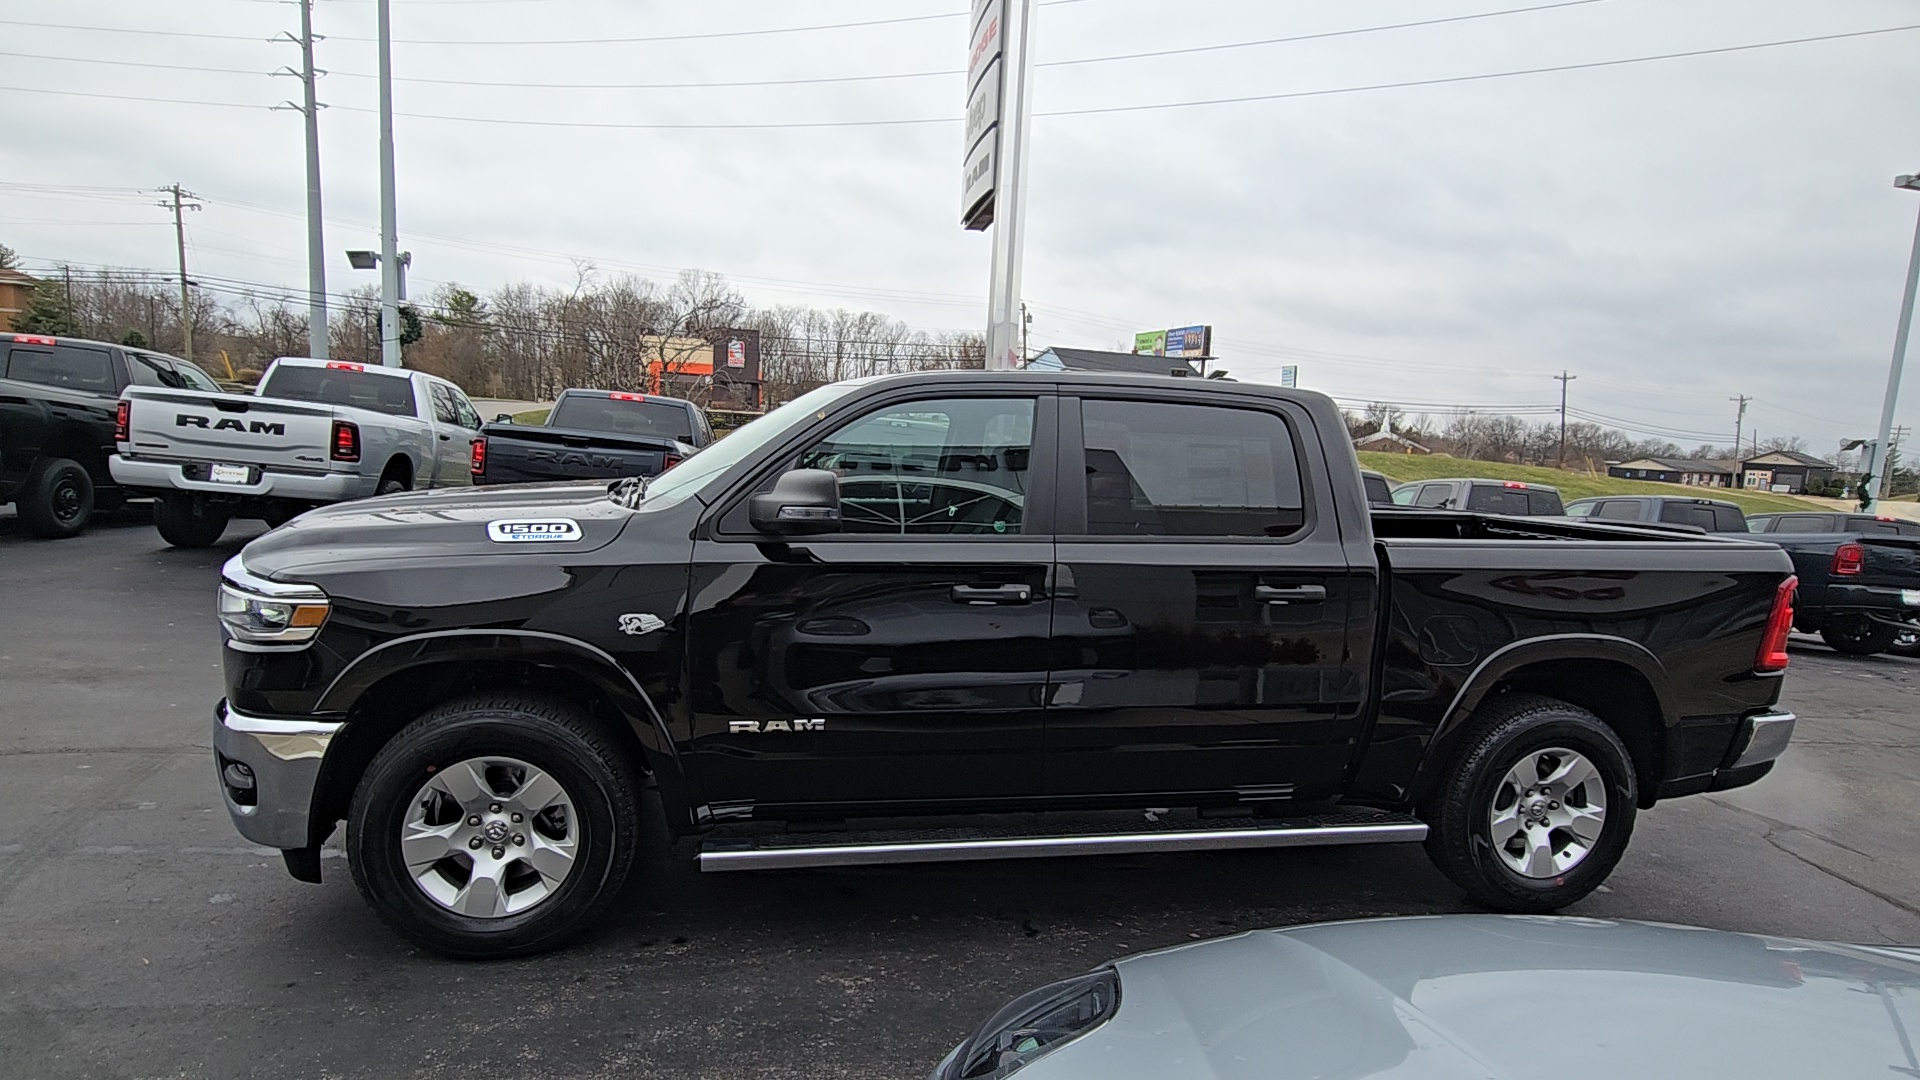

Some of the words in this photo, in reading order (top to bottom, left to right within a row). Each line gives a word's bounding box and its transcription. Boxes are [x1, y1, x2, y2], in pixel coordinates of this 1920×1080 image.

[175, 413, 286, 436] RAM
[526, 448, 624, 469] RAM
[502, 523, 568, 533] 1500
[728, 718, 826, 734] RAM
